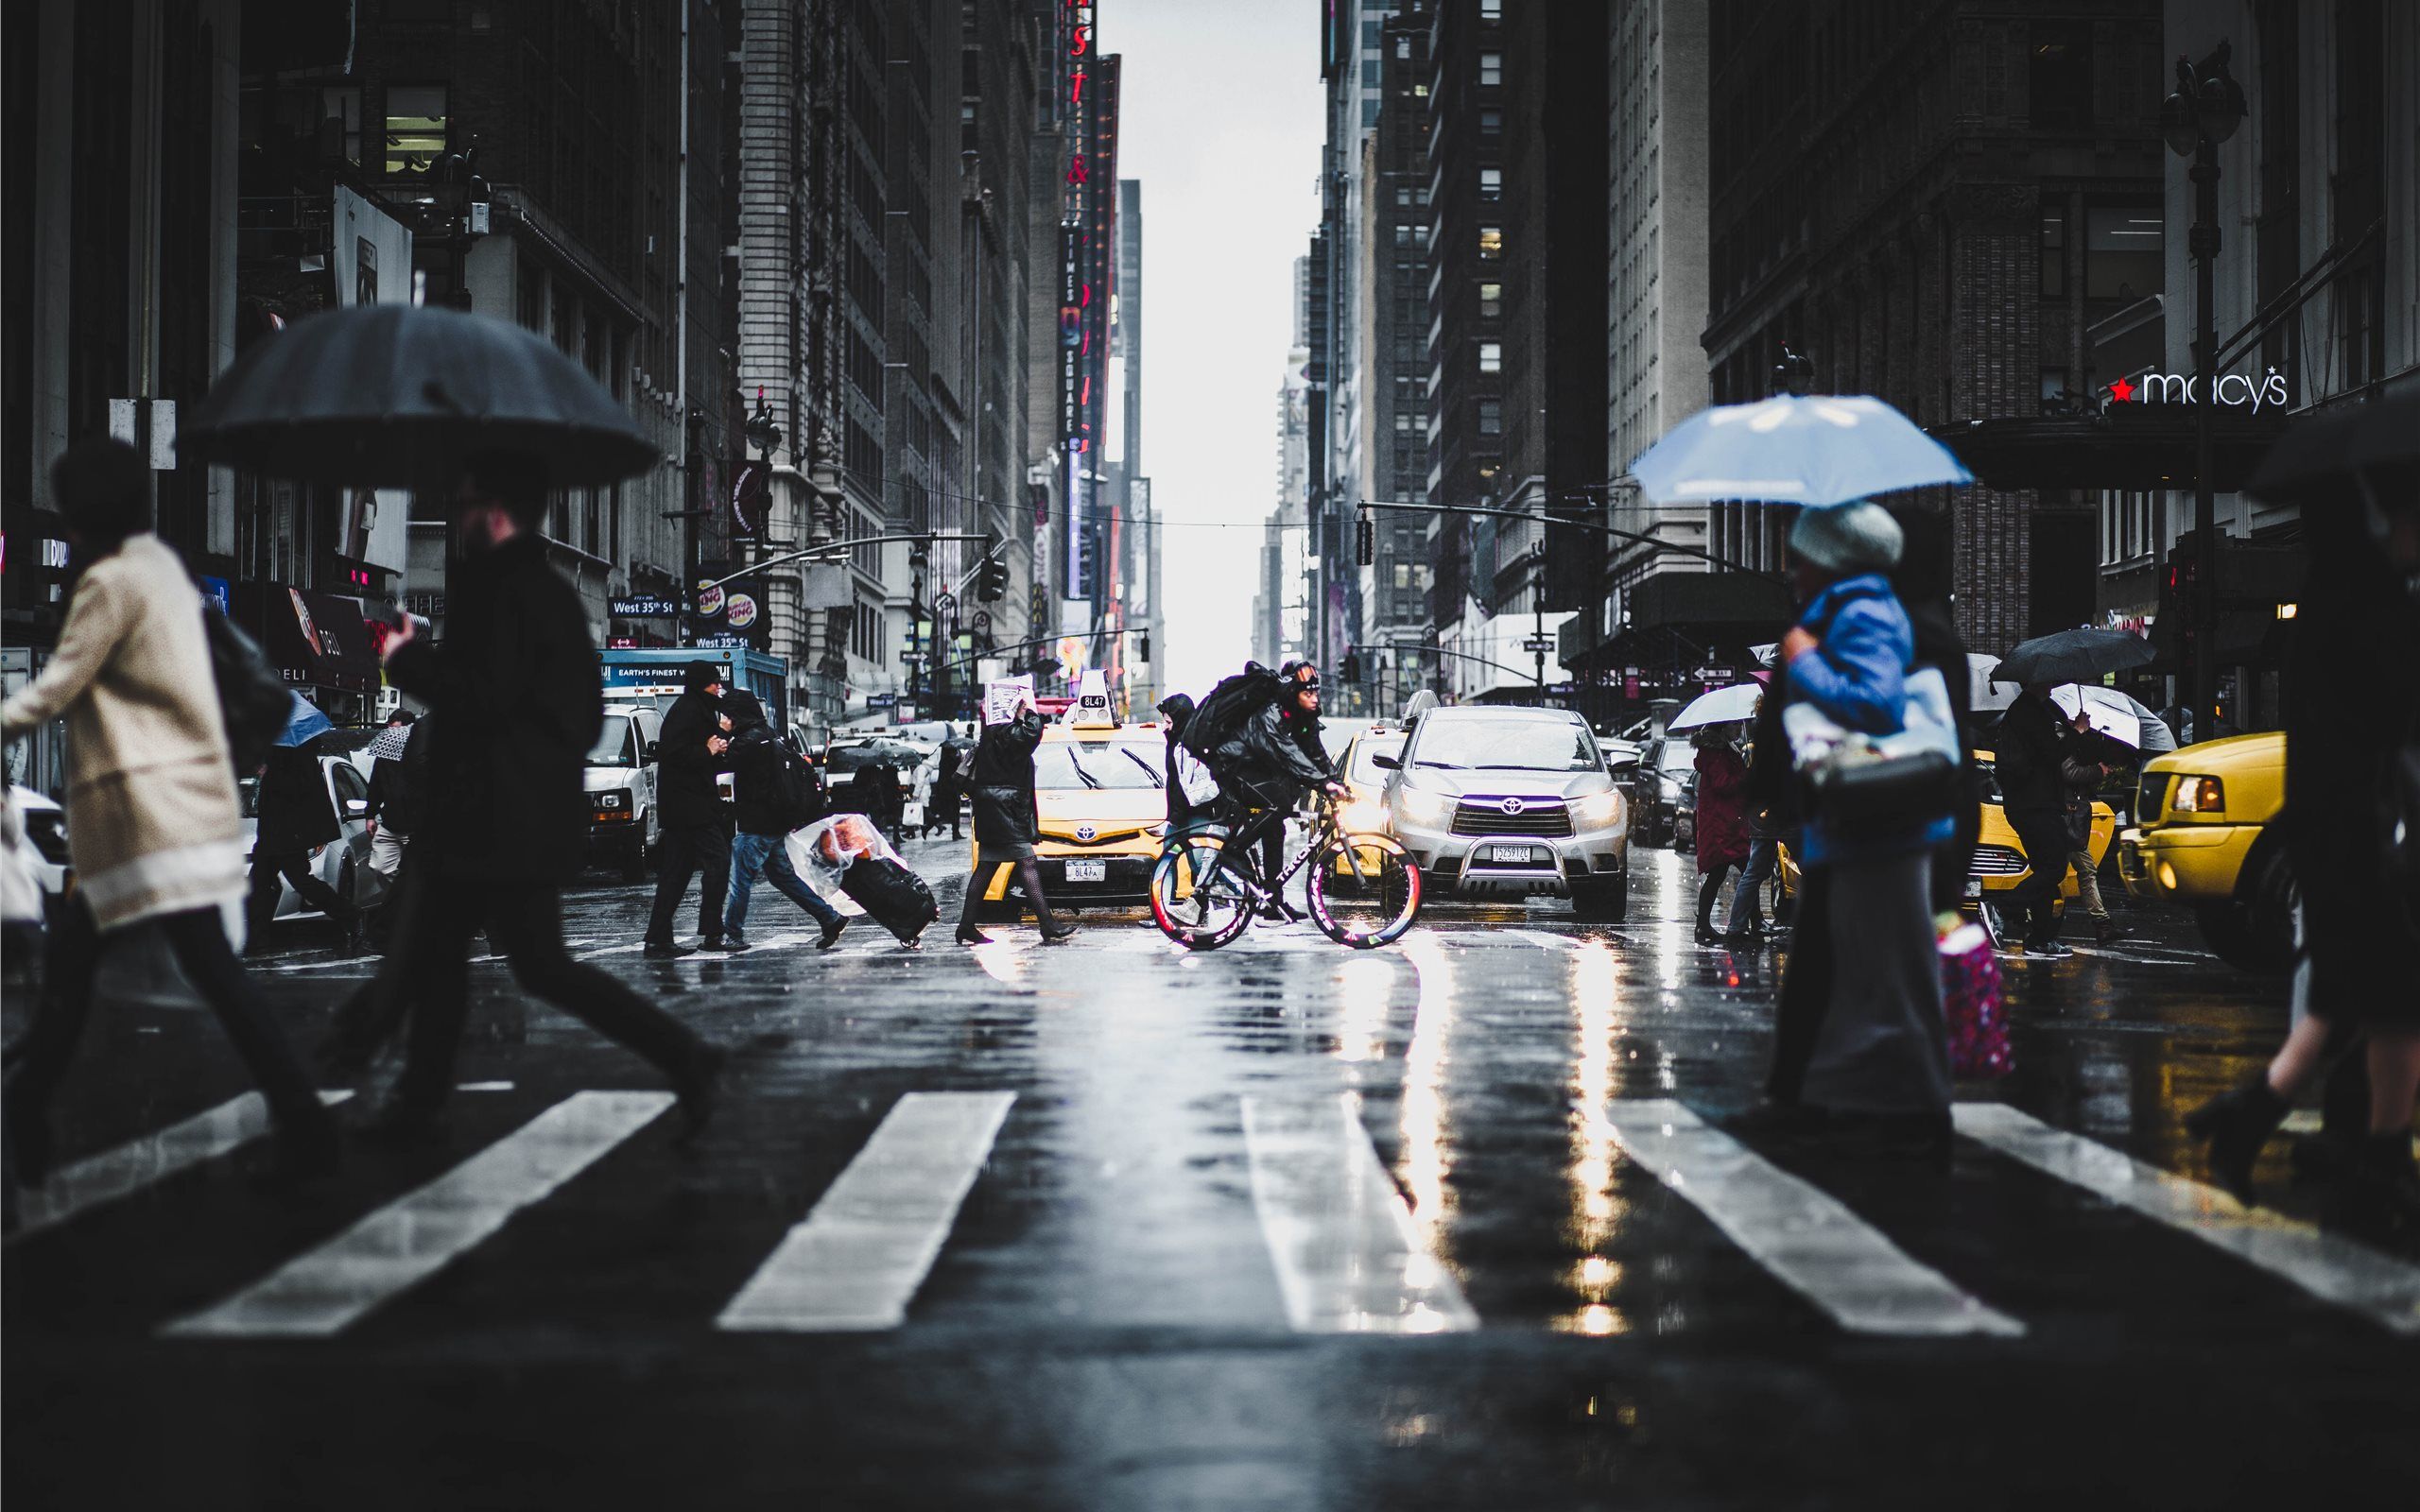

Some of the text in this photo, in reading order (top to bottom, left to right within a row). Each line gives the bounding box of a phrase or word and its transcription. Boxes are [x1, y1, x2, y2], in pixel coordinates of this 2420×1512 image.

[614, 602, 640, 613] West
[642, 602, 661, 613] 35th
[664, 603, 673, 613] St
[697, 638, 719, 648] West
[739, 637, 749, 647] St
[1084, 696, 1104, 706] 8L47
